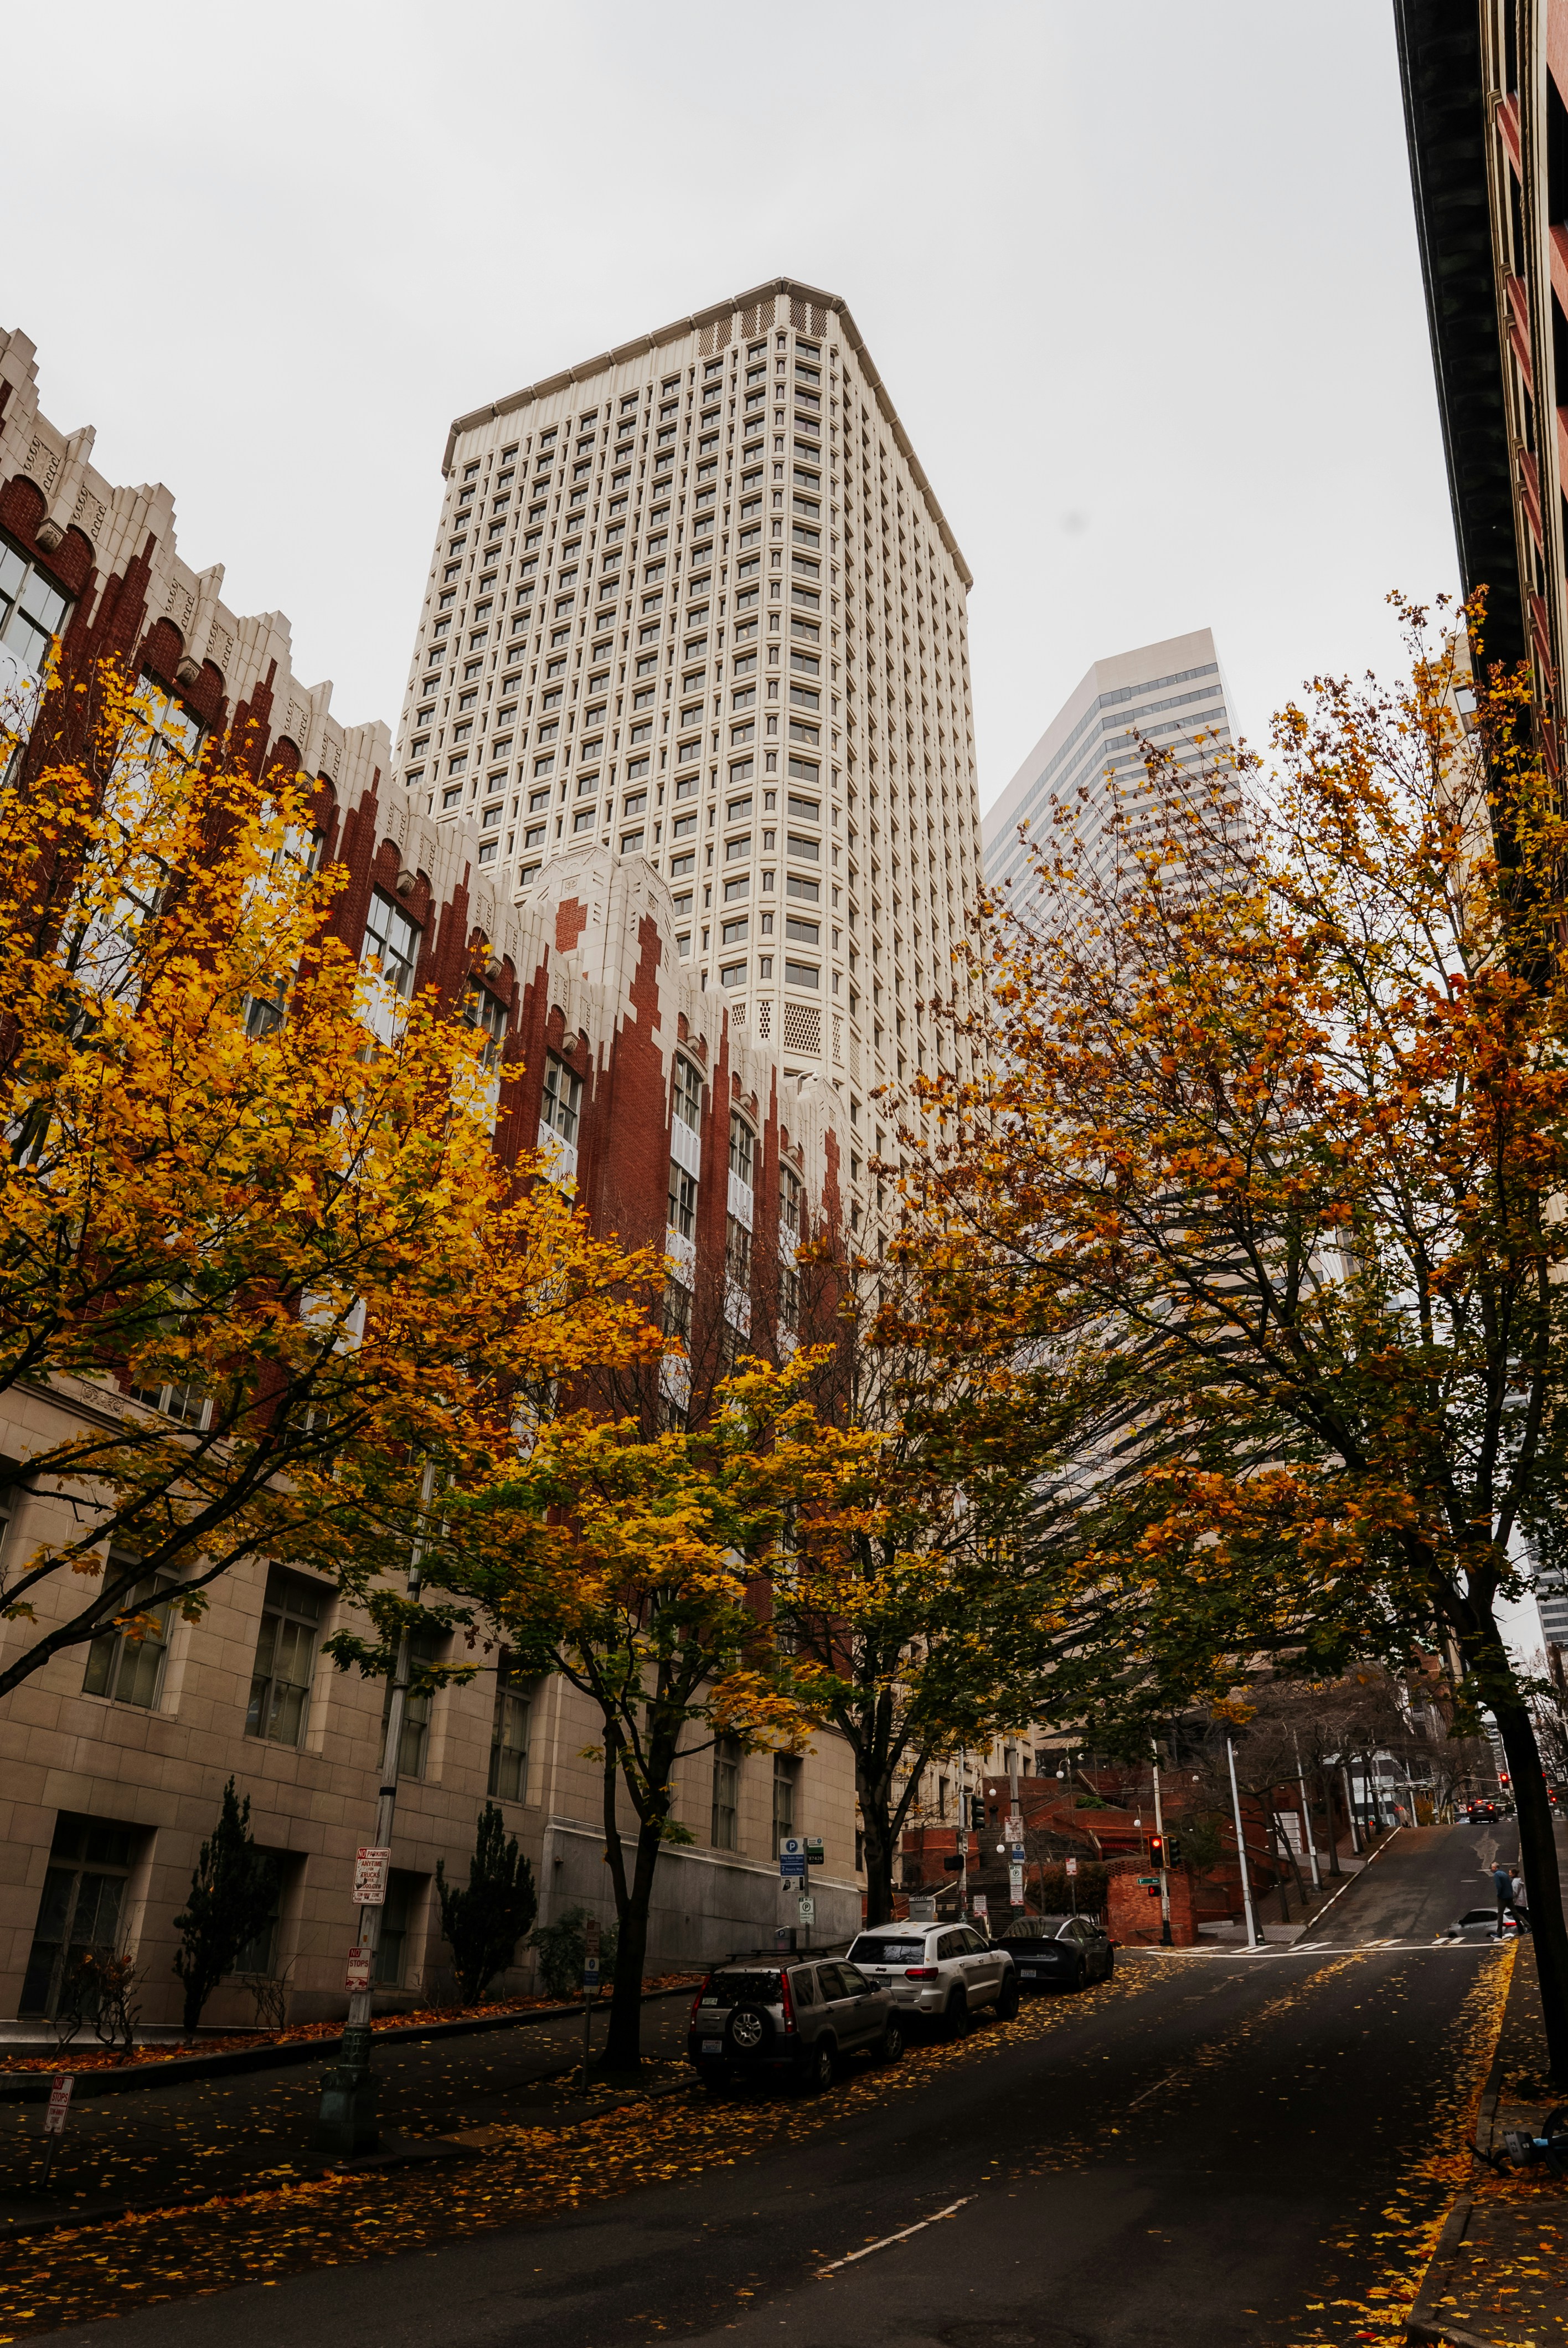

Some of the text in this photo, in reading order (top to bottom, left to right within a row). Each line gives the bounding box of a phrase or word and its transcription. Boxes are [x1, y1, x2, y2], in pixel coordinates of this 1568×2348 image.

[358, 1850, 366, 1858] NO
[54, 2078, 63, 2088] NO
[51, 2092, 69, 2102] STOPS
